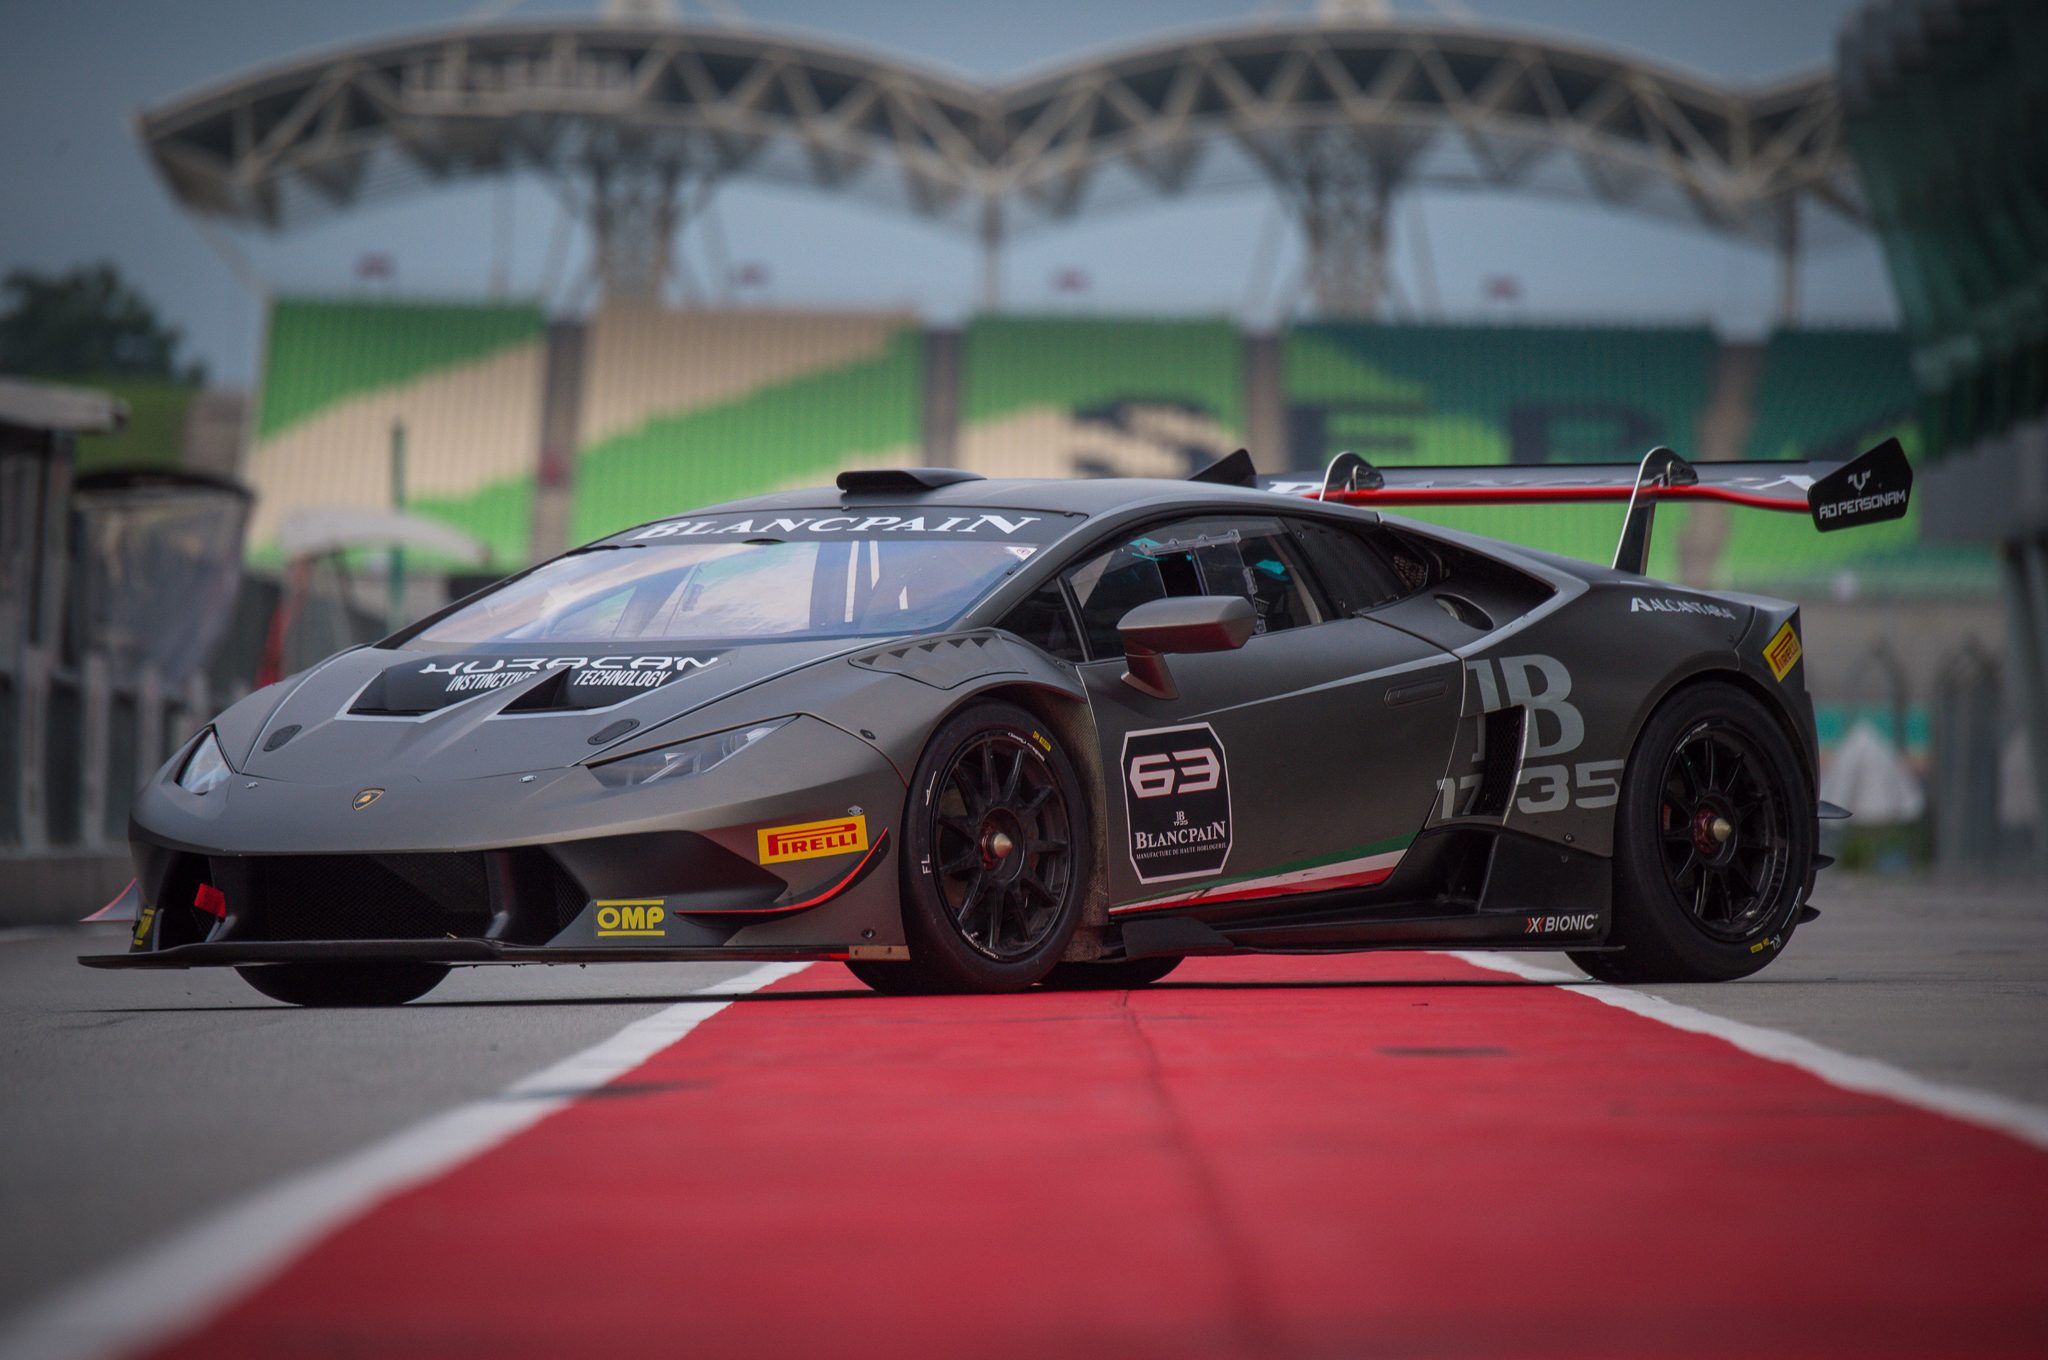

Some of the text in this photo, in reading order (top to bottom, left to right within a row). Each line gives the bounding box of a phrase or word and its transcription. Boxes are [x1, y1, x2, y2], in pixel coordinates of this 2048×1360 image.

[1819, 489, 1906, 520] AD PERSONAM
[626, 514, 1041, 541] BLANCPAIN
[1649, 598, 1737, 620] ALCANTARA
[1769, 630, 1800, 673] PIRELLI
[573, 669, 673, 688] TECHNOLOGY
[1129, 747, 1221, 799] 63
[1436, 759, 1625, 819] 1735
[767, 822, 858, 857] PIRELLI
[1134, 820, 1226, 850] BLANCPAIN
[1136, 848, 1172, 860] MANUFACTURE
[1179, 845, 1196, 854] HAUTE
[1196, 842, 1226, 853] HORLOGERIE
[597, 906, 665, 930] OMP
